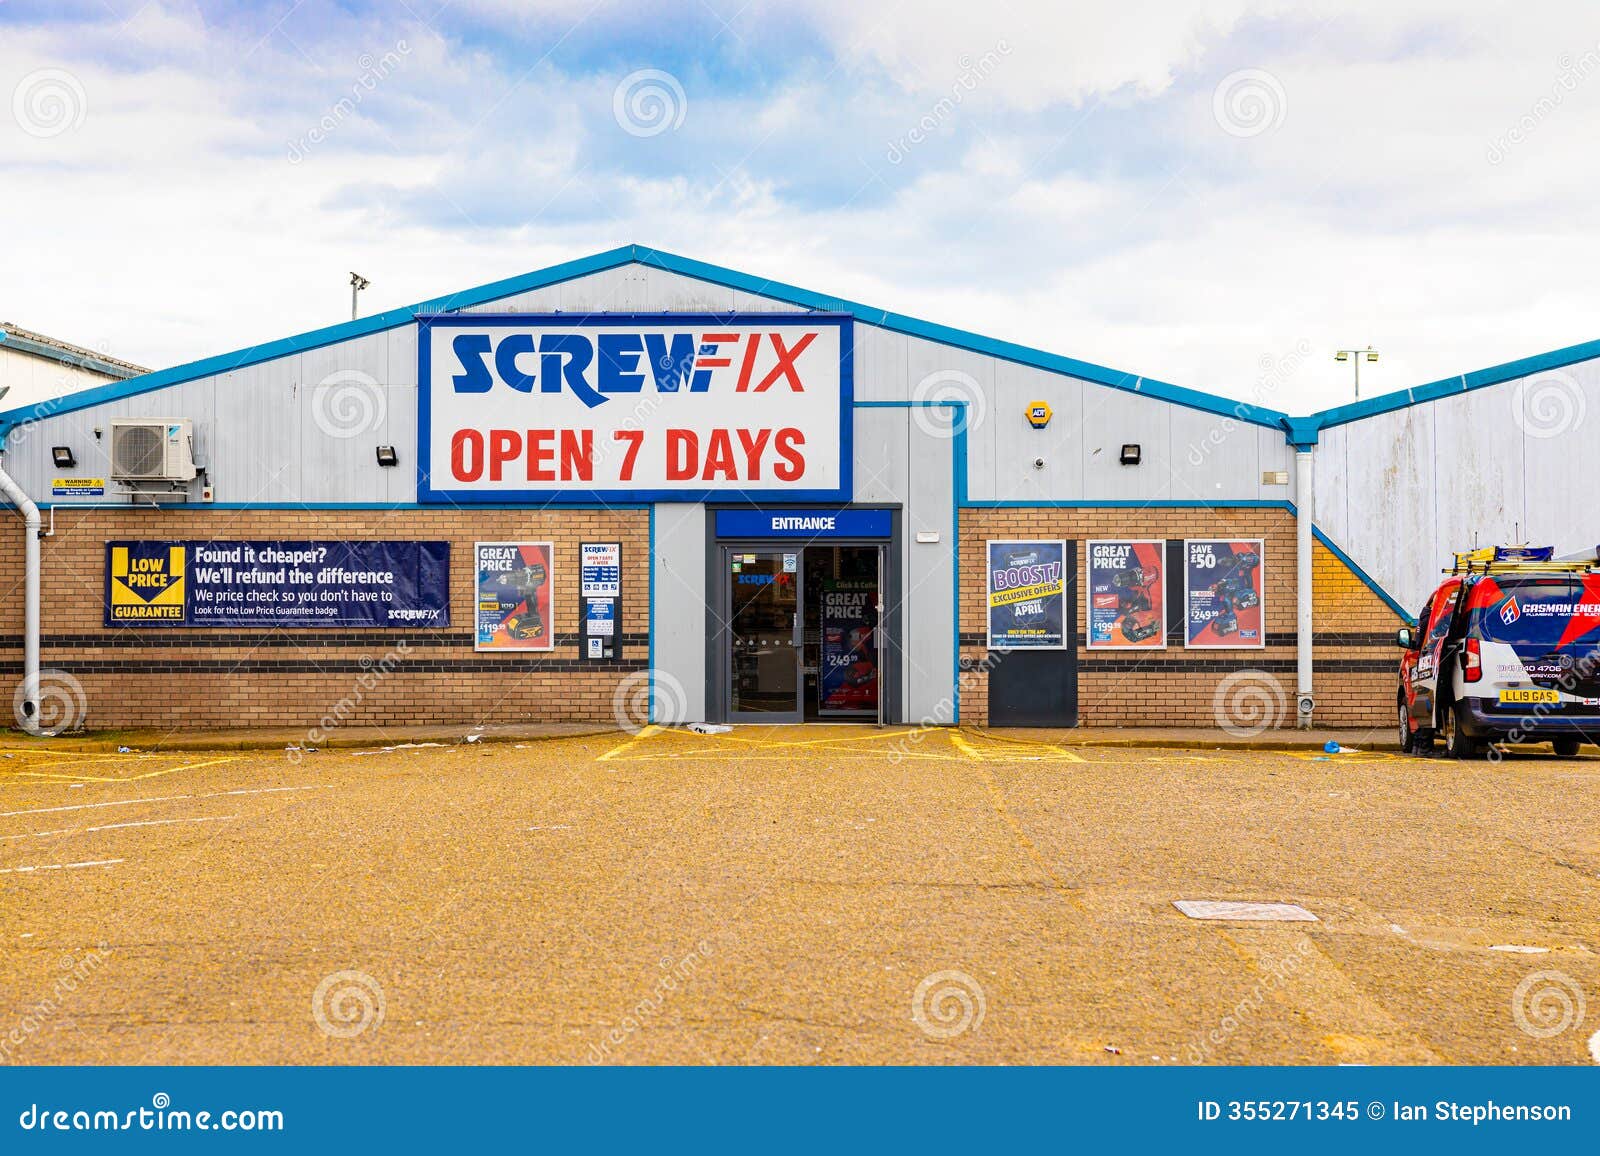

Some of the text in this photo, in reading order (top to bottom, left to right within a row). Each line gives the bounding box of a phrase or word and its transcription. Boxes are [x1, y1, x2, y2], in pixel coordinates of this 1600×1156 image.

[452, 333, 819, 408] SCREWFIX
[451, 428, 806, 482] OPEN 7 DAYS
[772, 517, 835, 530] ENTRANCE
[480, 548, 517, 560] GREAT
[1094, 545, 1131, 557] GREAT
[1191, 545, 1212, 554] SAVE
[196, 547, 327, 566] Found it cheaper?
[1191, 553, 1216, 569] £50
[132, 559, 164, 573] LOW
[480, 560, 513, 571] PRICE
[1094, 558, 1127, 569] PRICE
[128, 574, 168, 587] PRICE
[195, 567, 394, 584] We'll refund the difference
[993, 561, 1061, 590] BOOST!
[195, 589, 392, 605] We price check so you don't have to
[825, 592, 868, 606] GREAT
[993, 584, 1061, 604] EXCLUSIVE OFFERS
[115, 607, 181, 618] GUARANTEE
[195, 606, 338, 617] Look for the Low Price Guarantee badge
[825, 606, 863, 619] PRICE
[1014, 603, 1043, 617] APRIL
[1522, 604, 1571, 613] GASMAN
[388, 610, 439, 621] SCREWFIX
[1506, 691, 1553, 701] LL19 GAS
